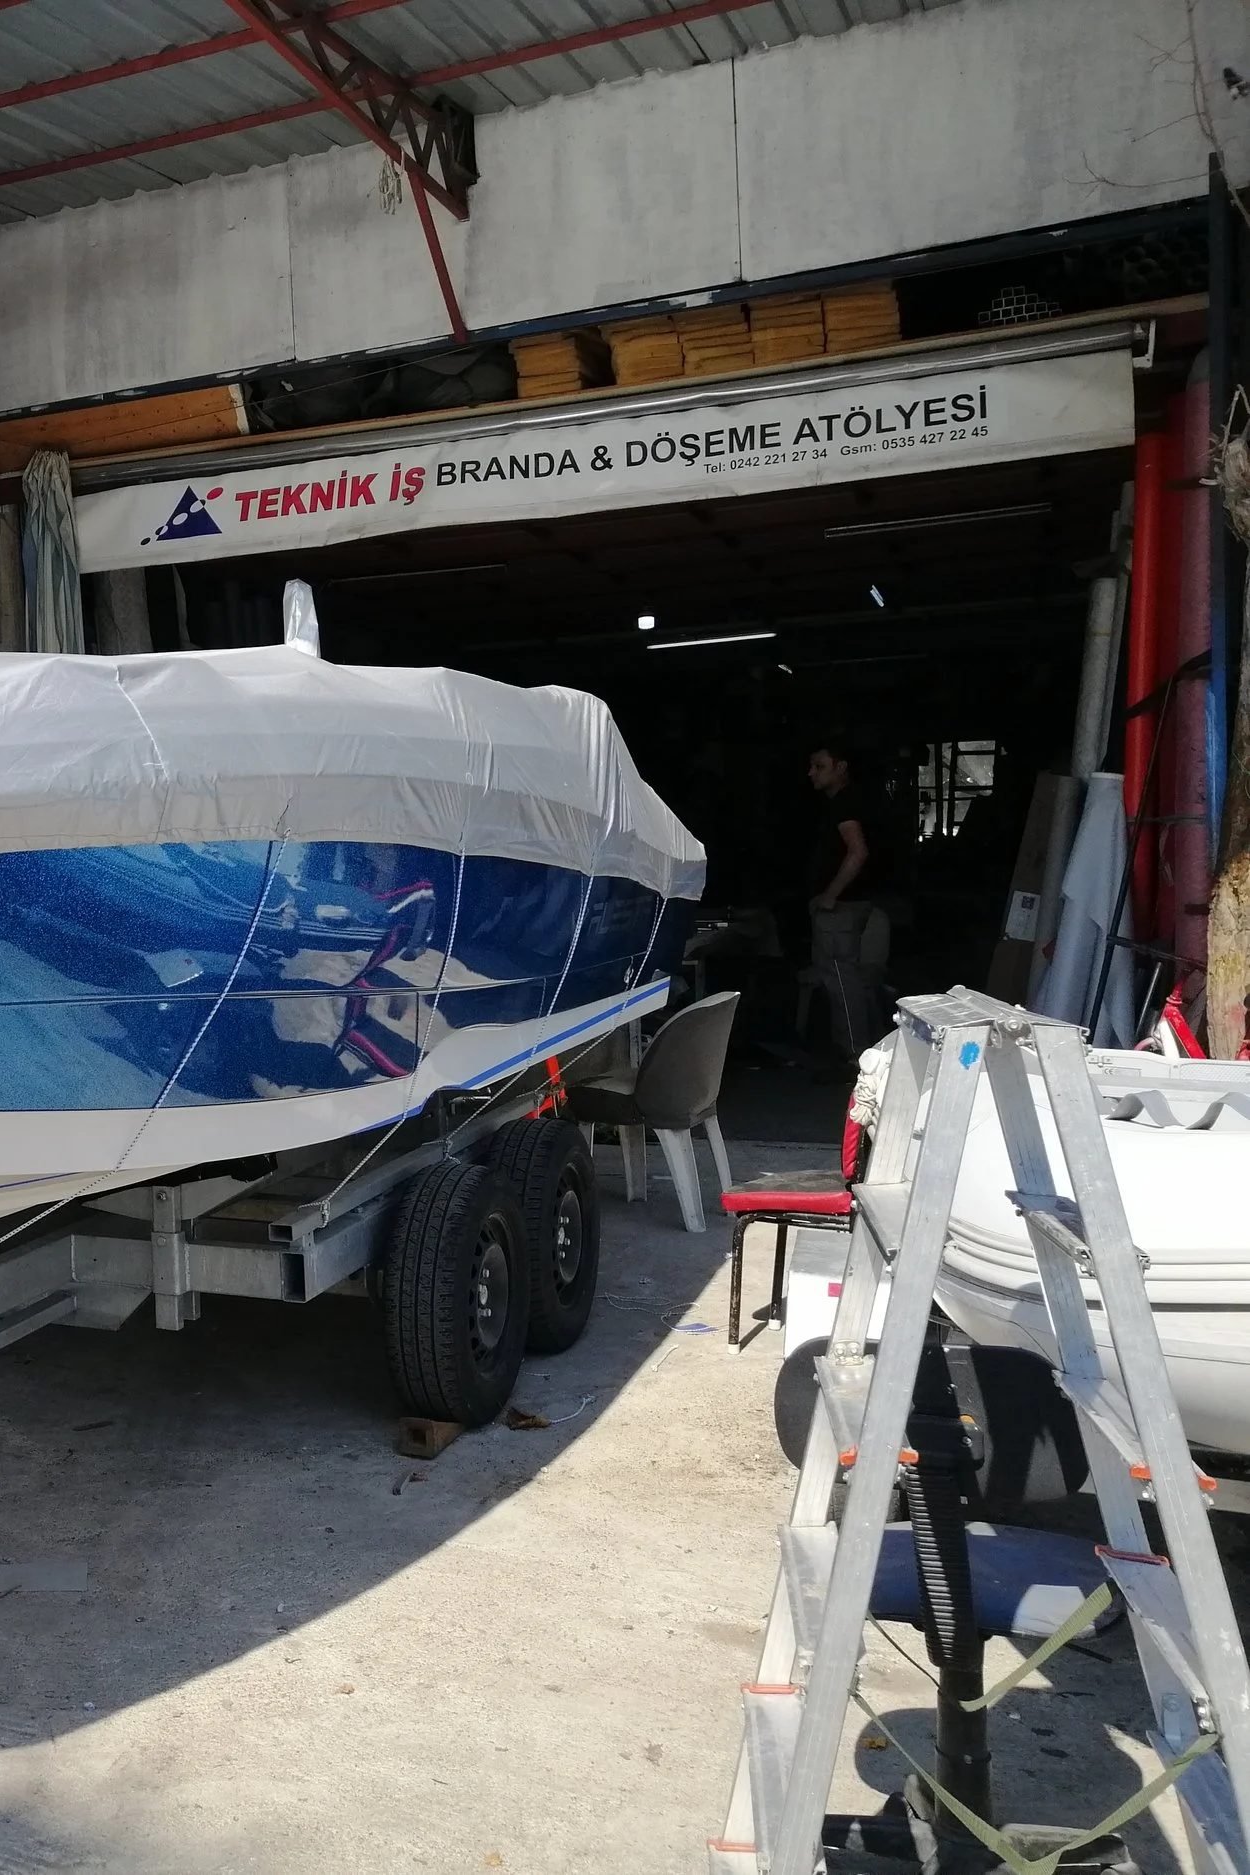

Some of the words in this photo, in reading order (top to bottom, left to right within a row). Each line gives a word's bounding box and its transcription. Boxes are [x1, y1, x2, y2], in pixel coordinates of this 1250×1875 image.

[234, 469, 378, 522] TEKNİK
[389, 462, 426, 506] İŞ
[436, 448, 581, 487] BRANDA
[590, 445, 614, 472] &
[625, 421, 782, 467] DÖŞEME
[792, 384, 988, 446] ATÖLYESİ
[703, 461, 726, 475] Tel:
[729, 455, 760, 471] 0242
[764, 452, 787, 466] 221
[791, 449, 808, 463] 27
[812, 447, 828, 460] 34
[839, 441, 877, 457] Gsm:
[881, 434, 916, 451] 0535
[919, 431, 945, 445] 427
[949, 428, 967, 442] 22
[970, 425, 989, 438] 45
